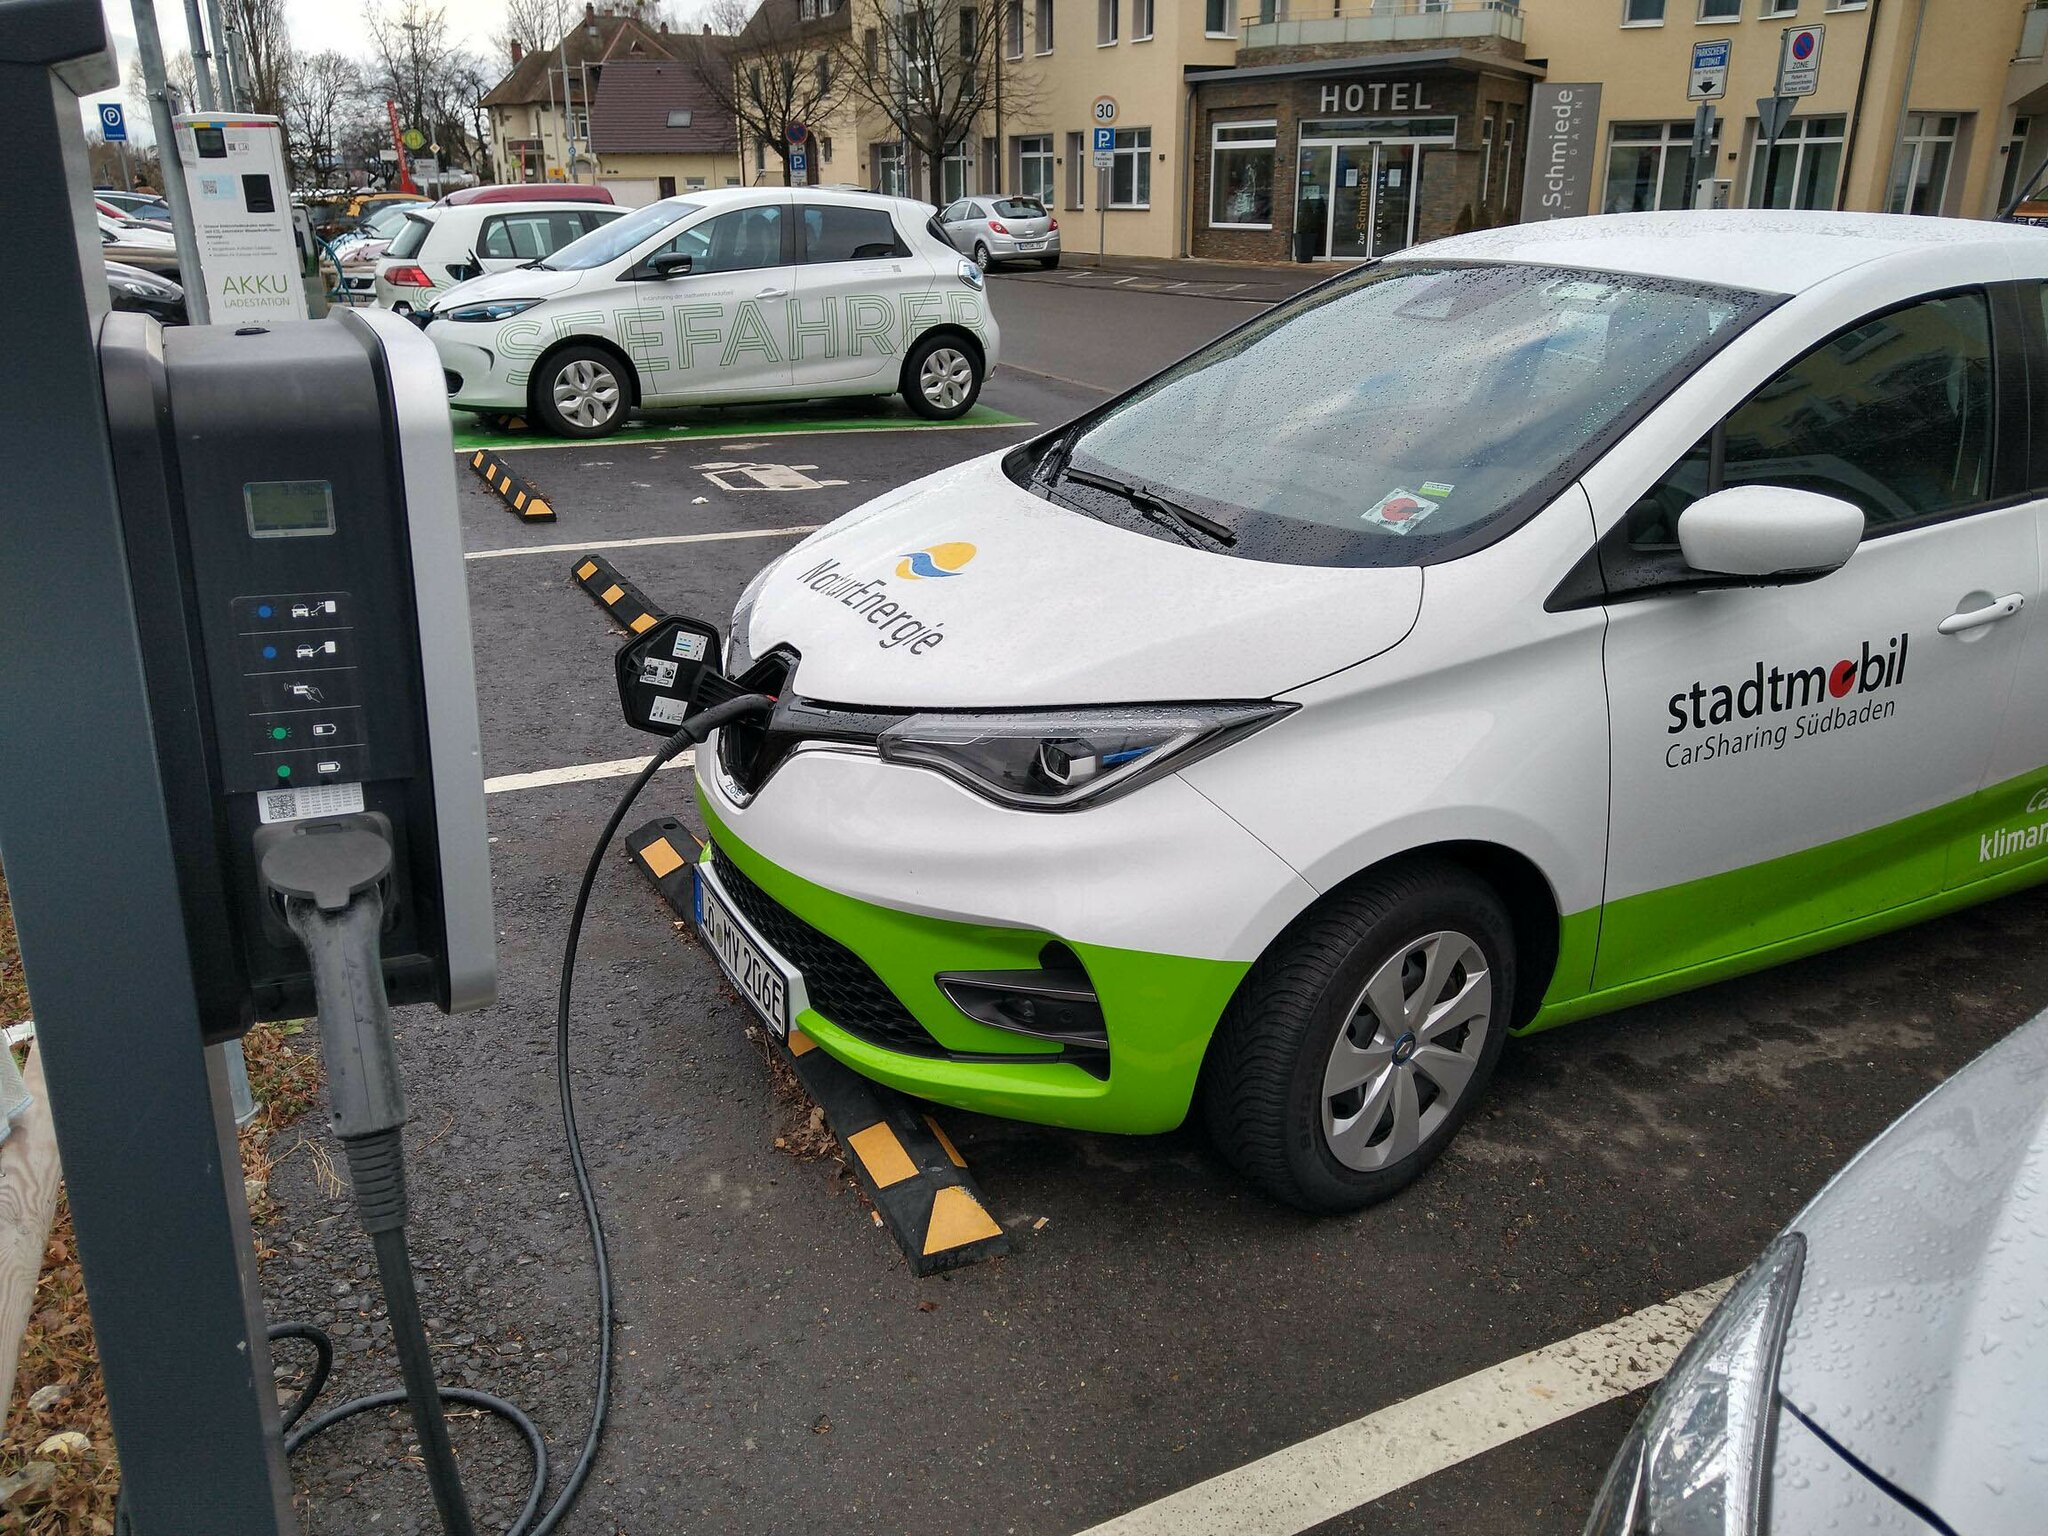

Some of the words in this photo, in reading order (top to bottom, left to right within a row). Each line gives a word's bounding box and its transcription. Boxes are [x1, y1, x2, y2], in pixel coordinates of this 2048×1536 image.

[1792, 61, 1809, 69] ZONE
[1320, 76, 1432, 112] HOTEL
[107, 111, 116, 122] P
[1096, 104, 1114, 118] 30
[1098, 130, 1111, 148] P
[1542, 89, 1572, 207] Schmiede
[793, 155, 803, 169] P
[1357, 177, 1369, 230] Schmiede
[1563, 175, 1575, 210] TEL
[223, 274, 288, 295] AKKU
[224, 297, 290, 308] LADESTATION
[796, 558, 944, 655] NaturEnergie
[1667, 633, 1909, 734] stadtmobil
[1665, 725, 1787, 768] CarSharing
[1794, 699, 1895, 740] Südbaden
[725, 781, 742, 799] ZOE
[723, 918, 740, 974] MY
[743, 946, 782, 1027] 206E
